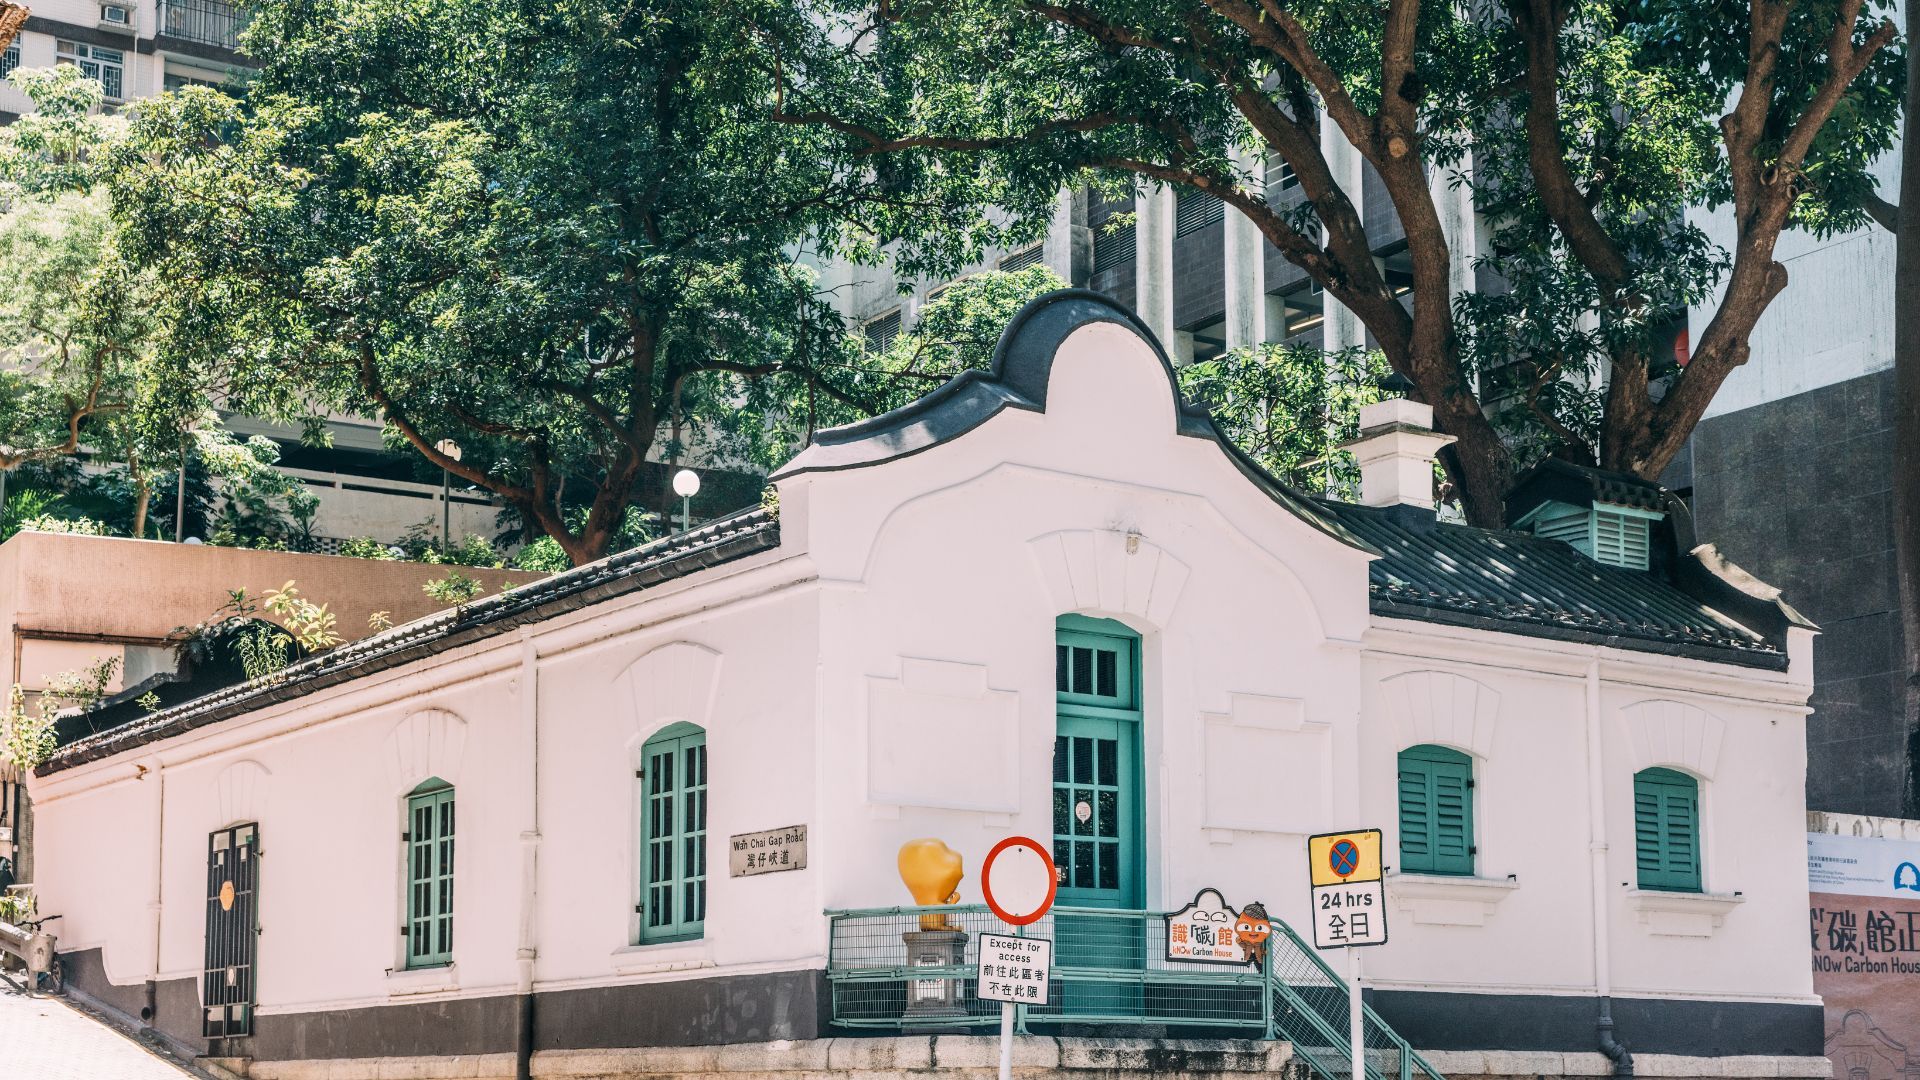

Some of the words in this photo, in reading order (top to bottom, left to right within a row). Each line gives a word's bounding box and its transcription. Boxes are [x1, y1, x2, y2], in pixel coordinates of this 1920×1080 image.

[734, 840, 748, 851] Wan
[751, 838, 766, 848] Chai
[769, 836, 782, 847] Gap
[786, 832, 804, 844] Road
[747, 850, 789, 868] 灣仔峽道
[1321, 892, 1341, 909] 24
[1346, 891, 1373, 907] hrs
[1172, 924, 1233, 946] 識「碳」館
[1329, 913, 1369, 940] 全日
[990, 939, 1022, 950] Except
[1028, 943, 1040, 952] for
[1192, 946, 1213, 956] Carbon
[1214, 948, 1232, 958] House
[999, 953, 1031, 963] access
[1813, 955, 1842, 973] NOw
[1845, 956, 1888, 973] Carbon
[983, 964, 1045, 981] 前往此區者
[989, 981, 1038, 998] 不在此限
